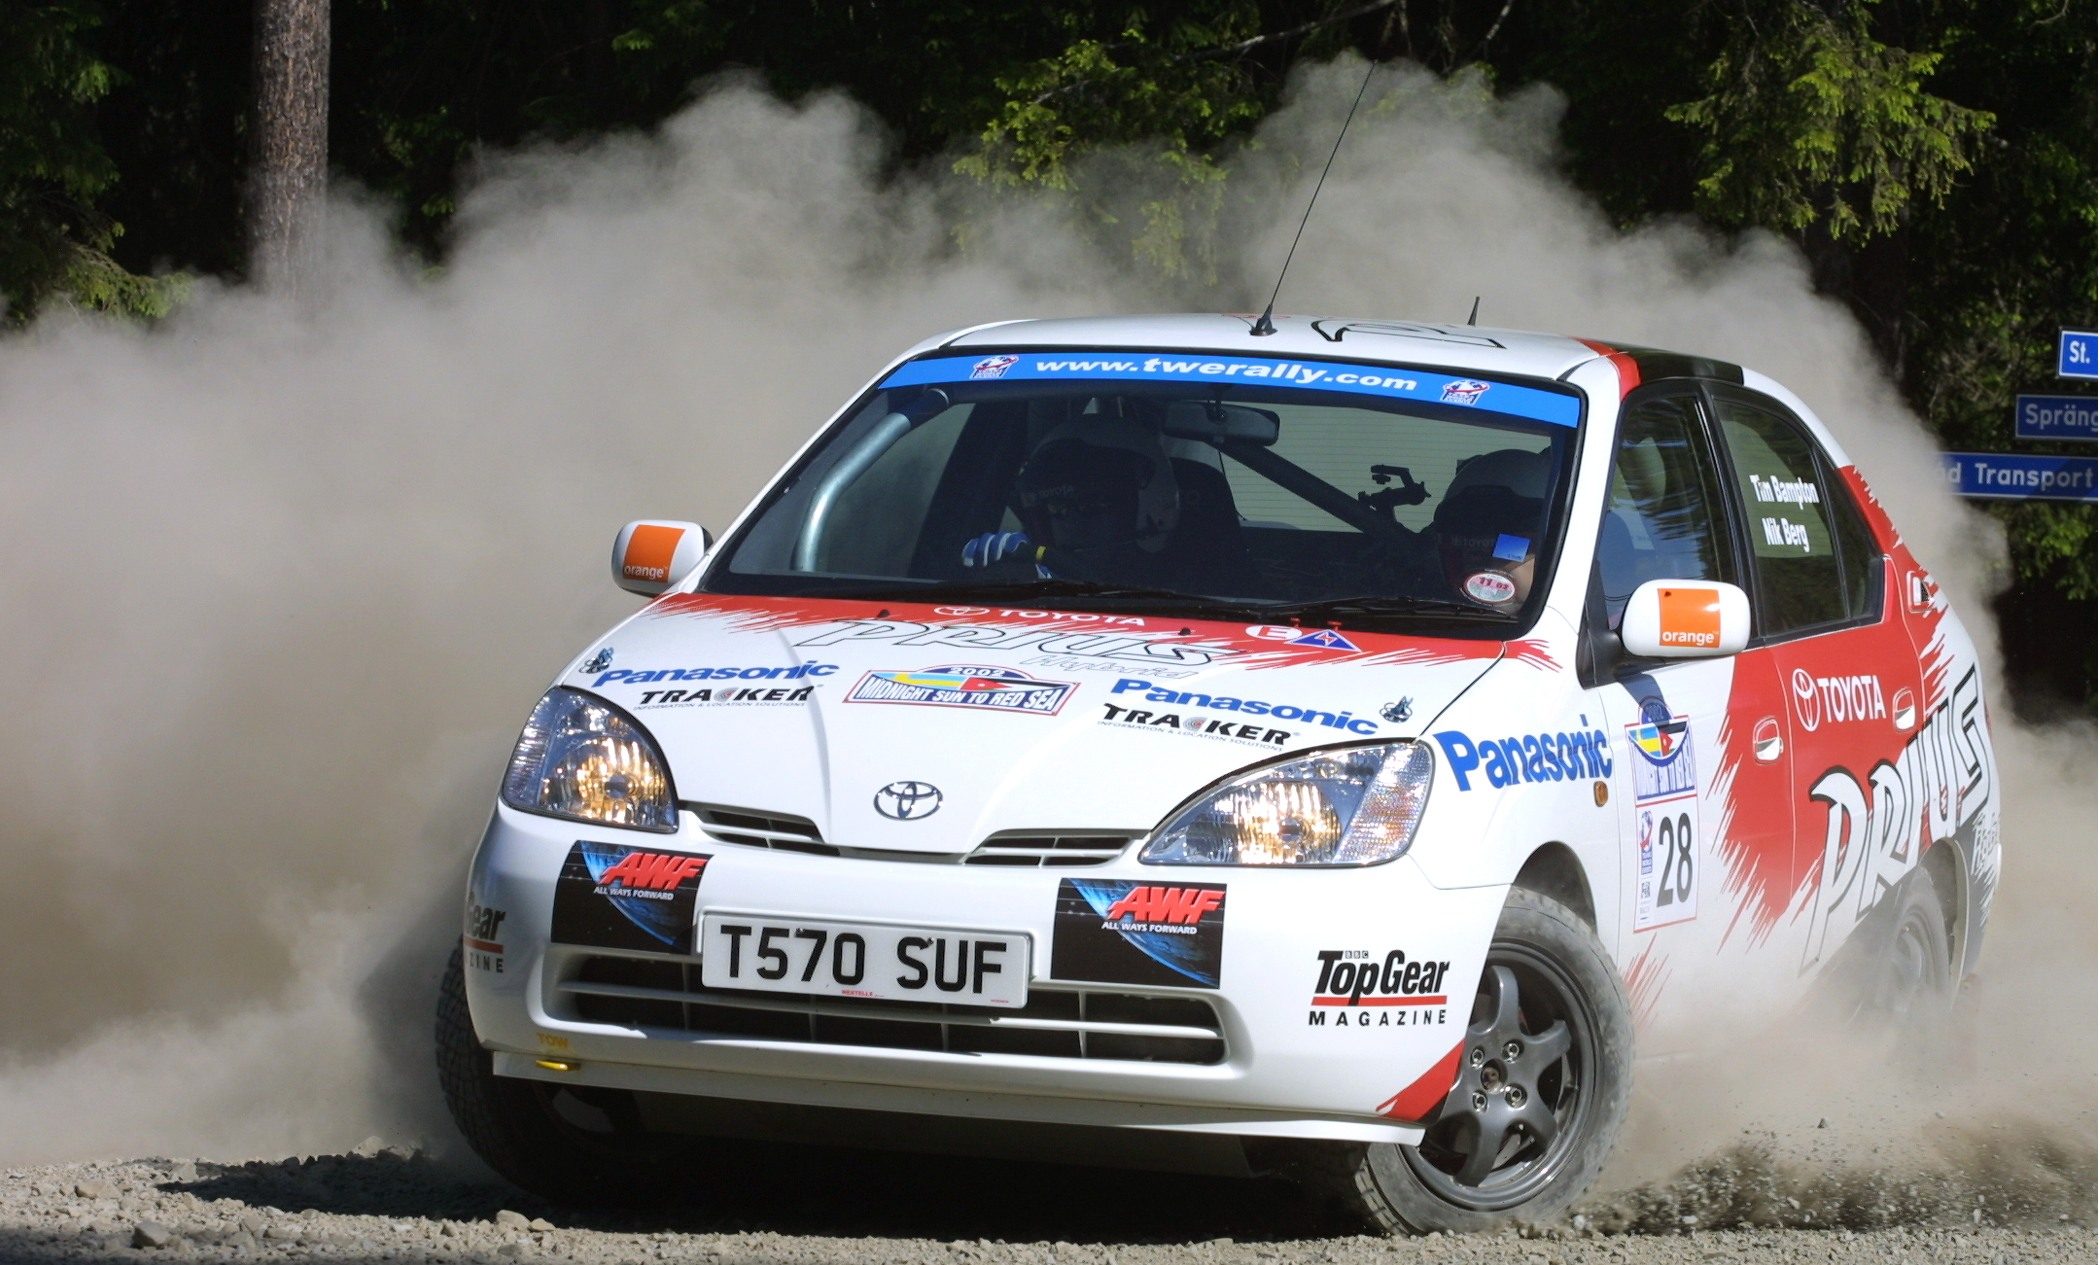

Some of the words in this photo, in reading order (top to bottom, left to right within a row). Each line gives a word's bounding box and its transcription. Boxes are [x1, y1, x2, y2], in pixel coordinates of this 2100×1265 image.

[2068, 340, 2090, 364] St.
[1035, 357, 1418, 391] www.twerally.com
[1749, 474, 1775, 502] Tim
[1974, 462, 2093, 491] Transport
[1761, 517, 1784, 545] Nik
[1780, 517, 1810, 552] Berg
[623, 565, 665, 580] orange
[1000, 608, 1146, 627] TOYOTA
[794, 618, 1243, 666] PRIUS
[1662, 631, 1715, 646] orange
[591, 660, 840, 688] Panasonic
[947, 667, 1006, 677] 2002
[1019, 654, 1199, 680] Hybrid
[859, 676, 934, 701] MIDNIGHT
[931, 689, 966, 703] SUN
[966, 691, 989, 705] TO
[988, 691, 1026, 708] RED
[1023, 688, 1064, 711] SEA
[1110, 678, 1379, 735] Panasonic
[1817, 675, 1887, 722] TOYOTA
[1097, 720, 1166, 734] INFORMATION
[1177, 730, 1227, 743] LOCATION
[1228, 737, 1285, 752] SOLUTIONS
[1432, 713, 1613, 792] Panasonic
[597, 852, 708, 891] AWF
[1656, 812, 1693, 908] 28
[593, 886, 608, 895] ALL
[609, 888, 632, 898] WAYS
[633, 889, 675, 901] FORWARD
[1105, 886, 1226, 926] AWF
[1101, 921, 1120, 931] ALL
[1121, 923, 1148, 933] WAYS
[1149, 924, 1198, 935] FORWARD
[720, 924, 867, 986] T570
[896, 936, 1008, 995] SUF
[1308, 1009, 1447, 1027] MAGAZINE
